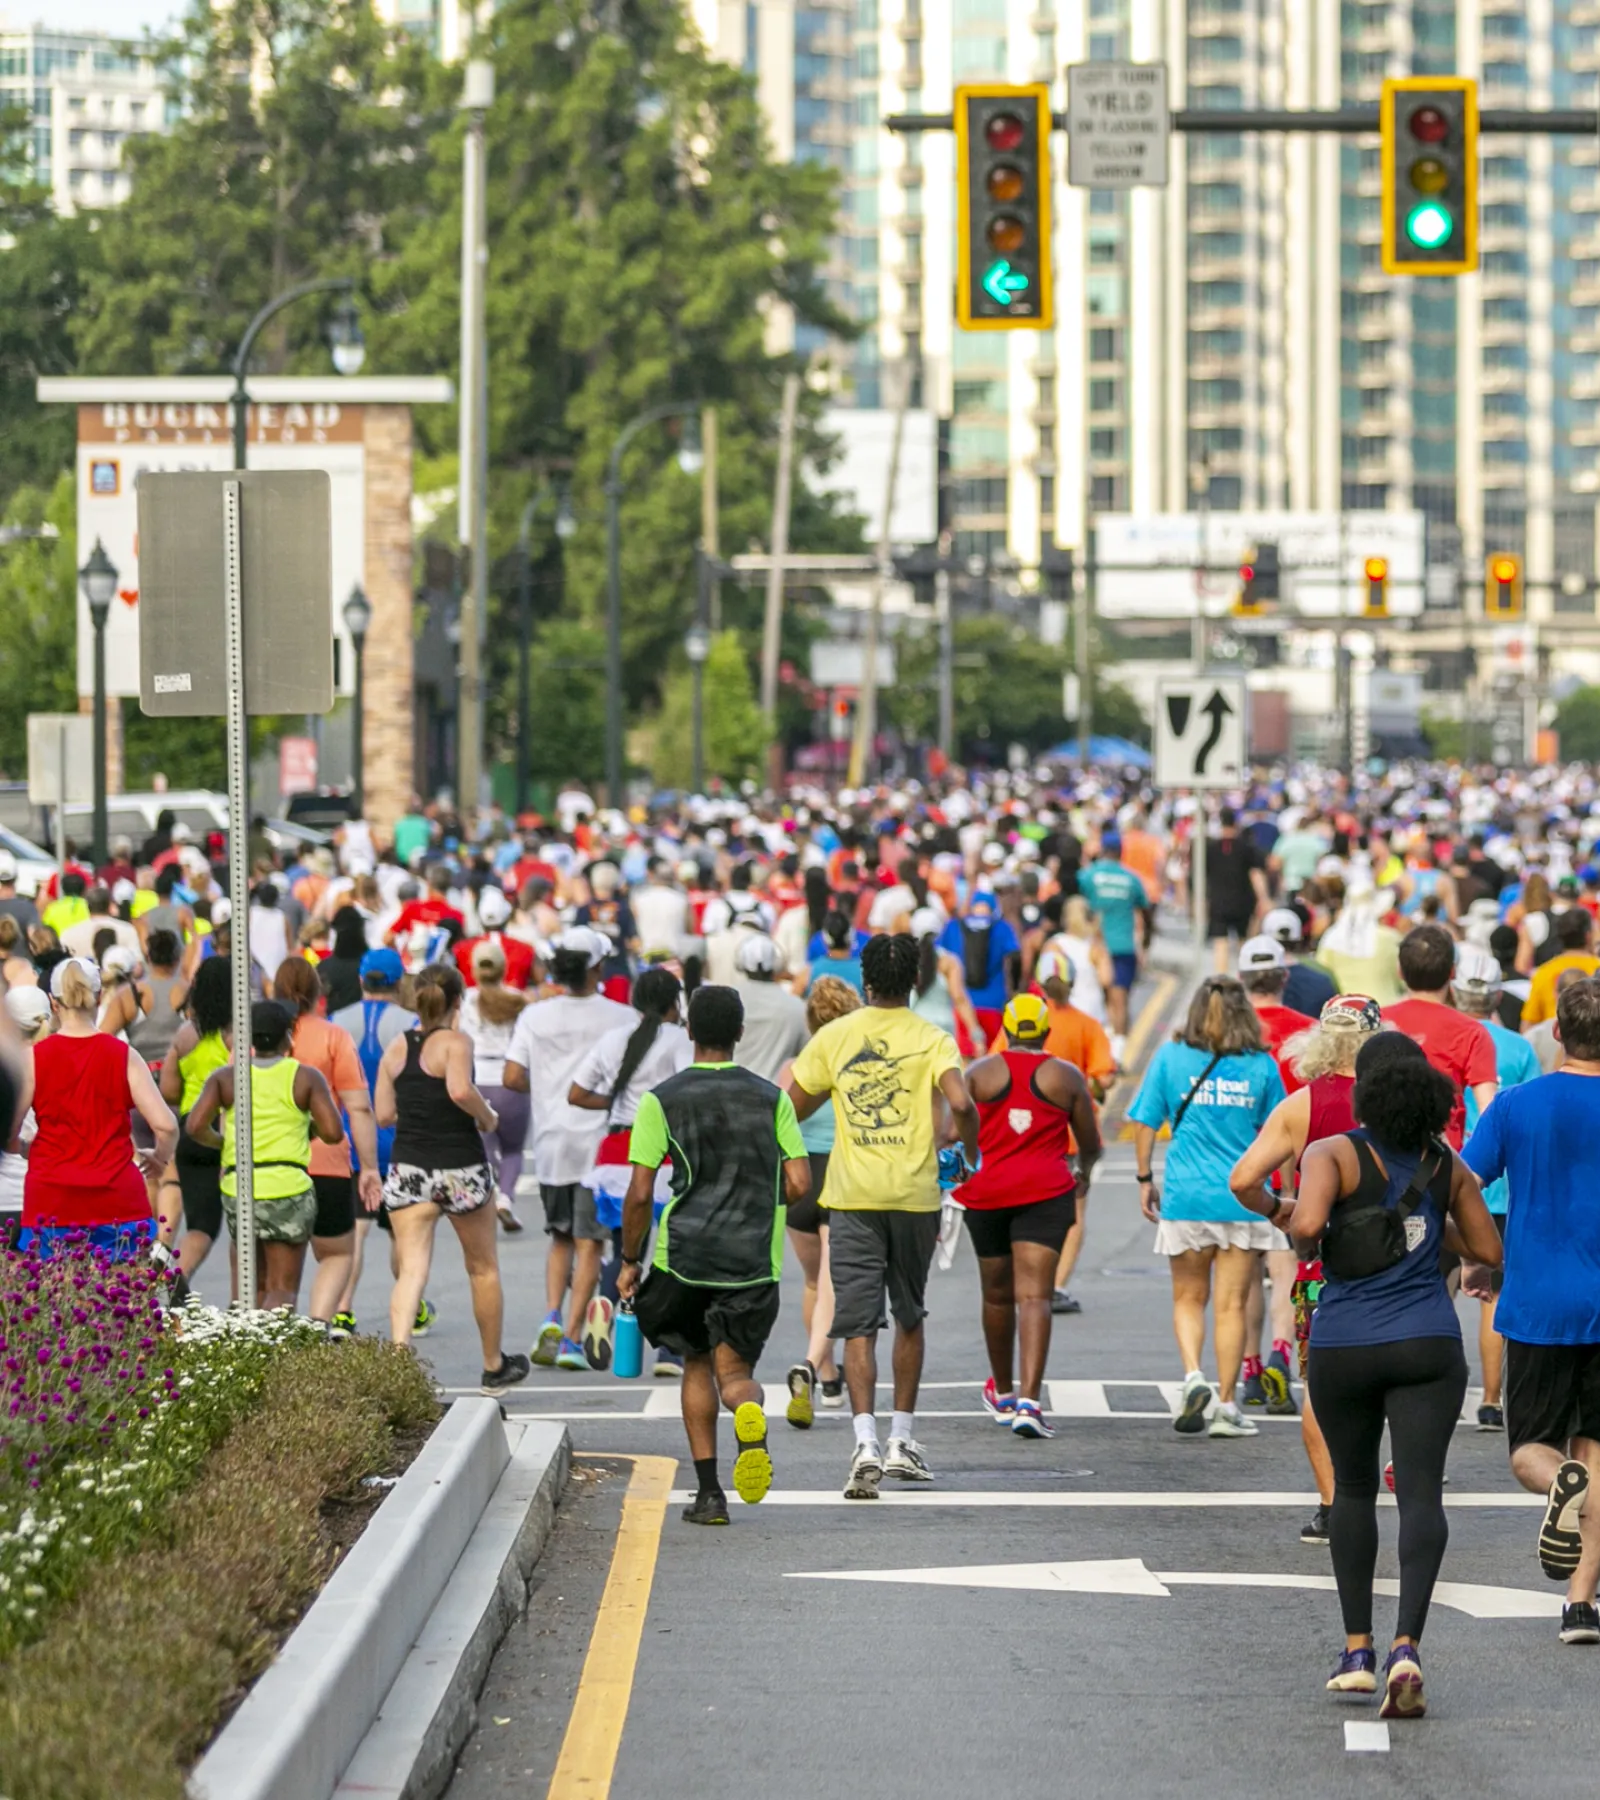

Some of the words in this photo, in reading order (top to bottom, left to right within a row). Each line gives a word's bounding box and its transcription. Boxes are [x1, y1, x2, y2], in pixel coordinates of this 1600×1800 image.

[1120, 70, 1157, 84] TURN
[1084, 91, 1153, 113] YIELD
[1089, 142, 1146, 157] YELLOW
[102, 402, 341, 429] BUCKHEAD
[1216, 1076, 1250, 1093] lead
[1216, 1092, 1256, 1109] heart
[852, 1134, 906, 1147] ALABAMA
